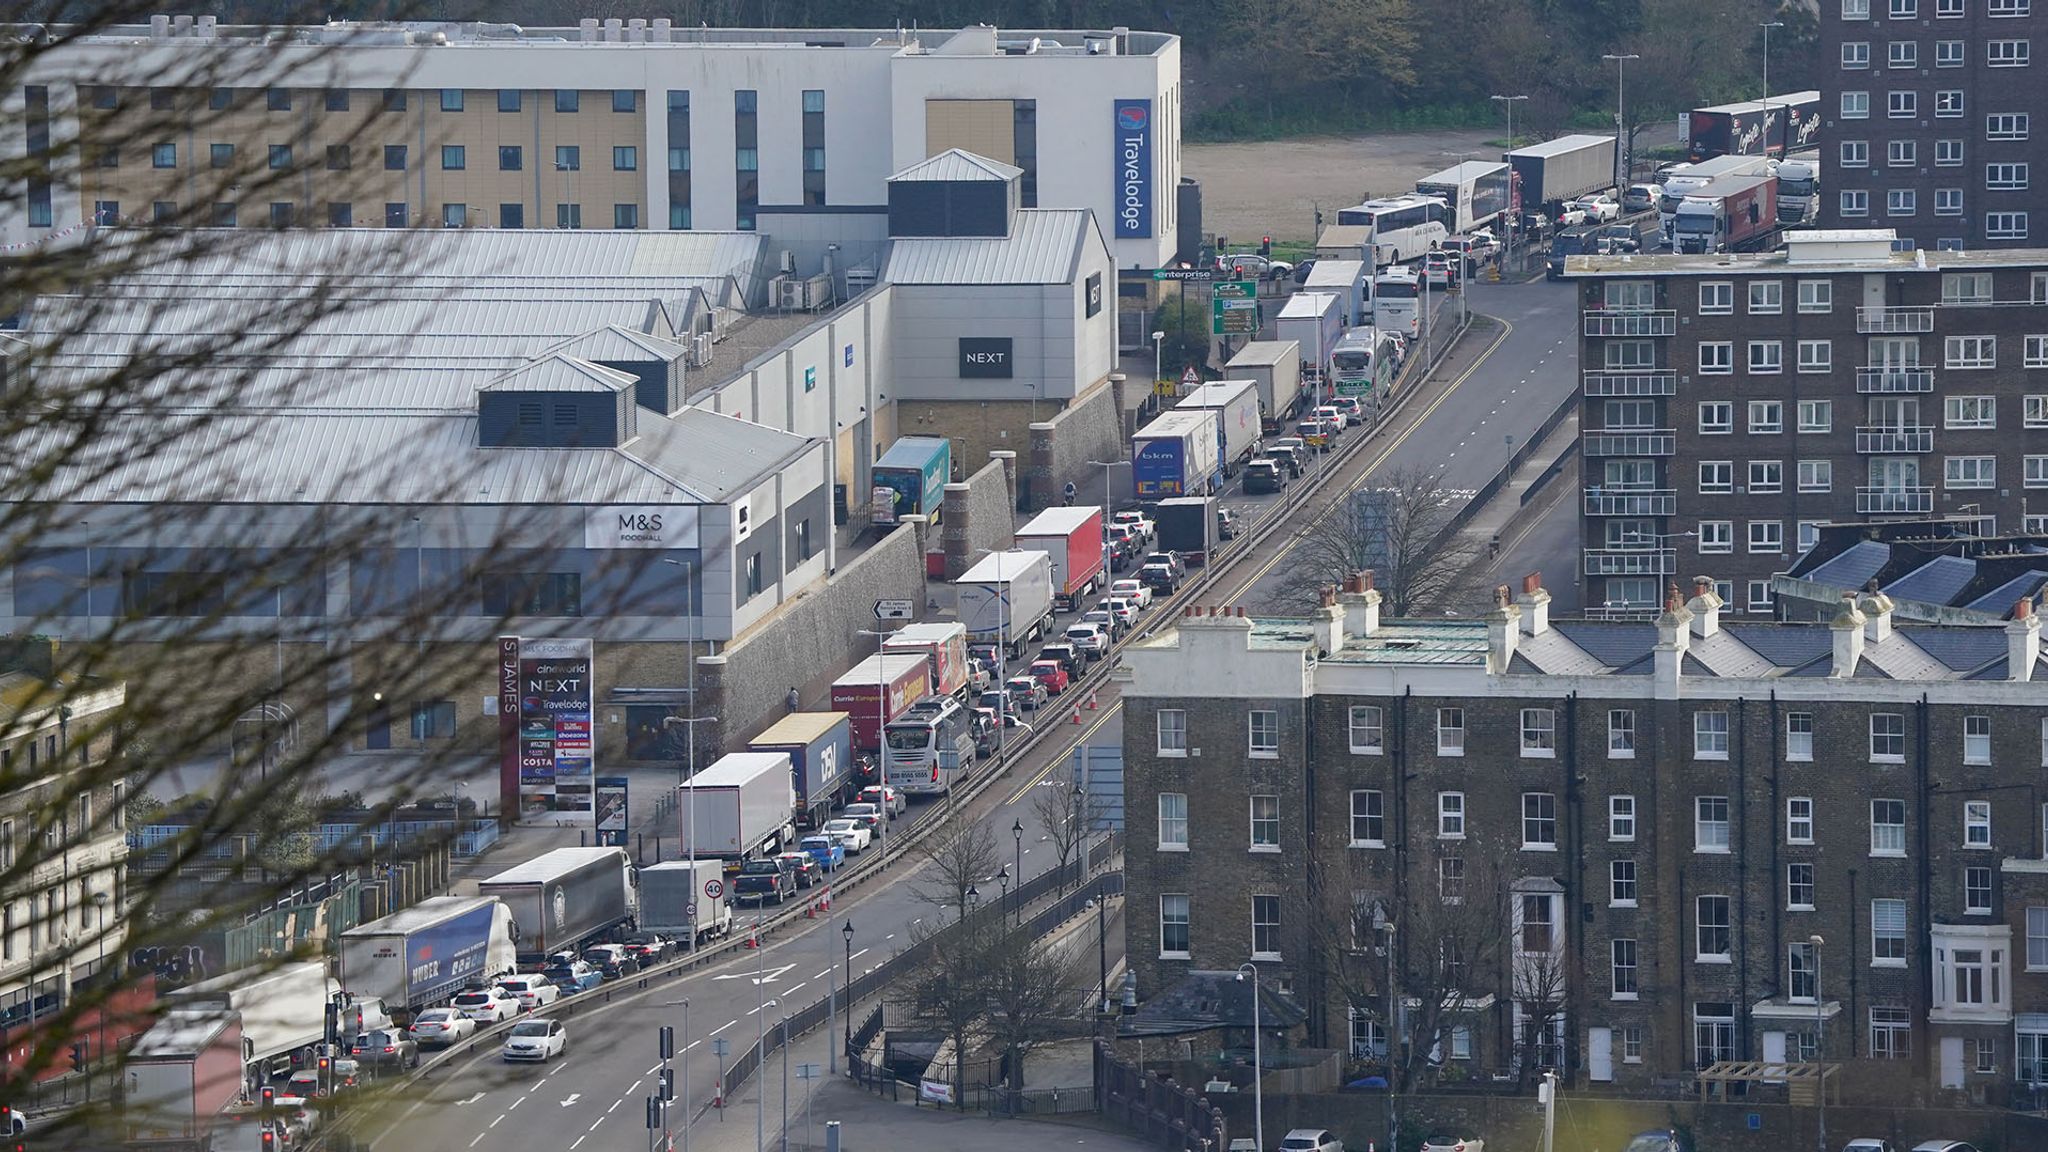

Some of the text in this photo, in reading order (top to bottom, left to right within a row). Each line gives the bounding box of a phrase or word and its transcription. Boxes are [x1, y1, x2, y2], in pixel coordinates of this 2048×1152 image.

[1121, 133, 1144, 230] Travelodge
[1154, 270, 1211, 279] enterprise
[966, 353, 1004, 363] NEXT
[618, 514, 663, 531] M&S
[504, 661, 517, 713] JAMES
[530, 680, 580, 692] NEXT
[542, 699, 588, 710] Travelodge
[523, 758, 552, 766] COSTA
[821, 742, 836, 783] DSV
[707, 884, 721, 893] 40
[412, 960, 439, 985] HUBER
